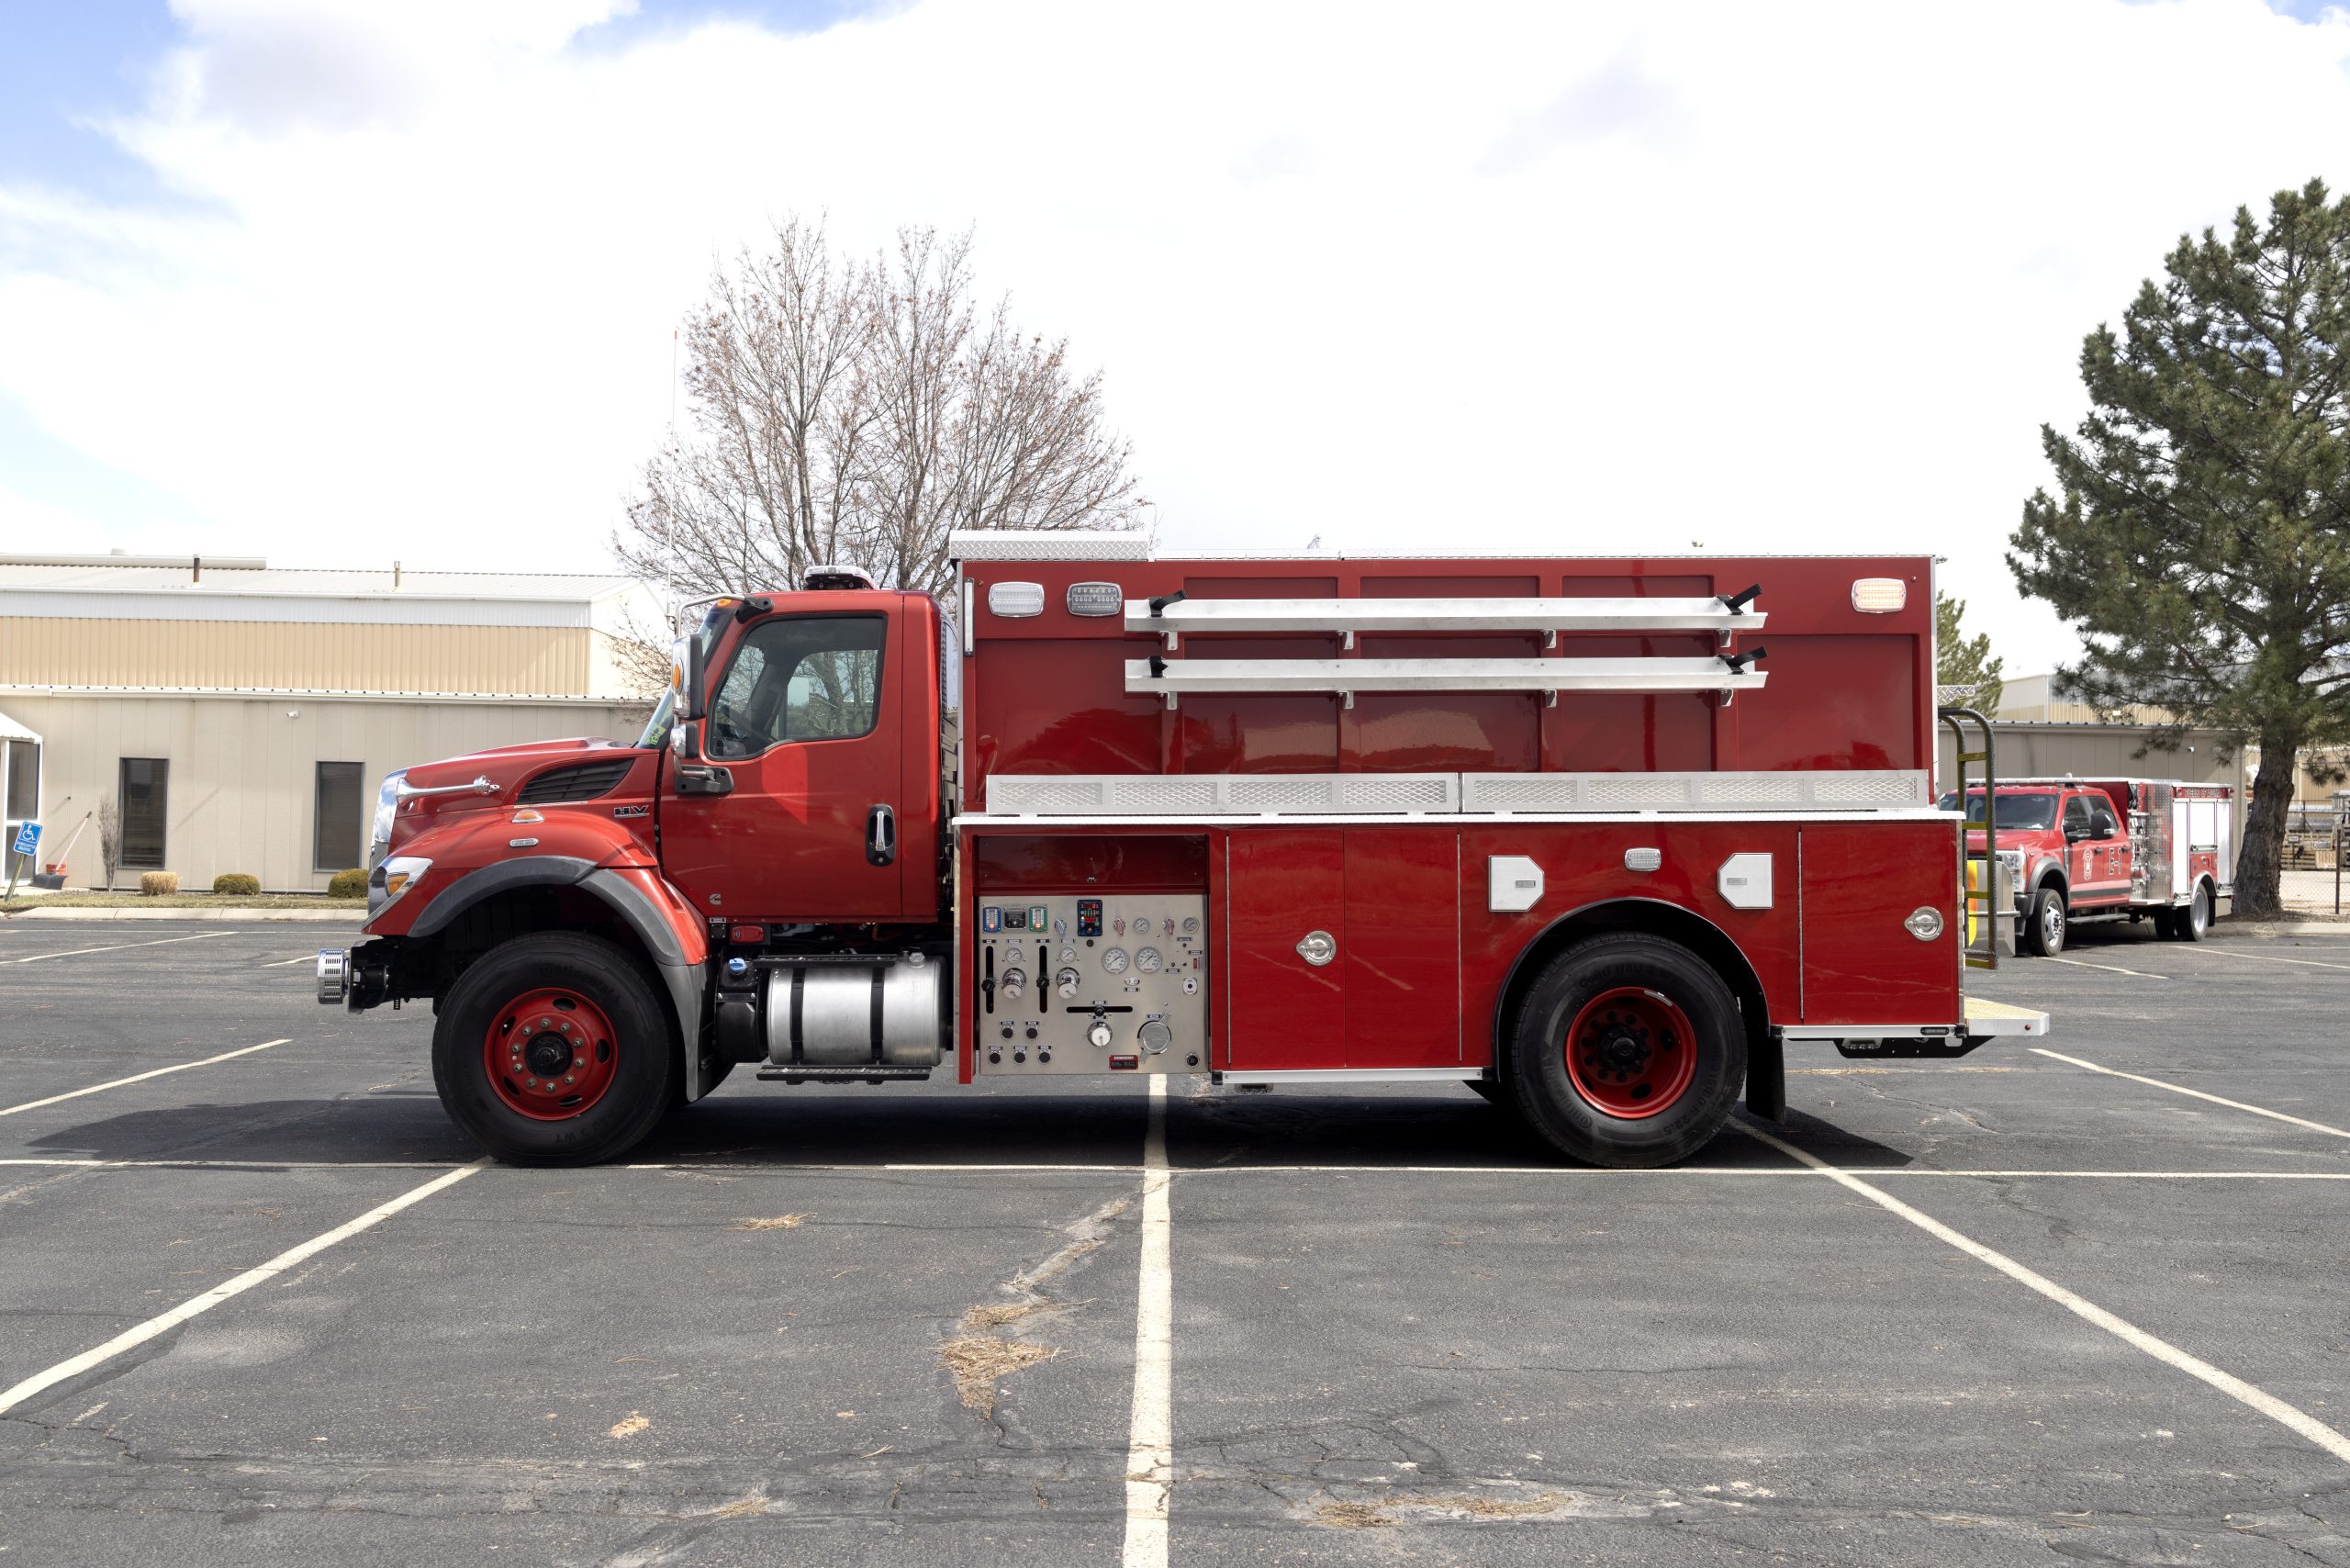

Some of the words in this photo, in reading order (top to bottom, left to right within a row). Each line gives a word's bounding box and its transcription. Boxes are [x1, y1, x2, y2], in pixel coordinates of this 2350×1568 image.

[614, 805, 649, 816] HV
[2109, 846, 2121, 875] E-1
[1578, 966, 1613, 989] Conti
[1662, 1114, 1690, 1136] 22.5
